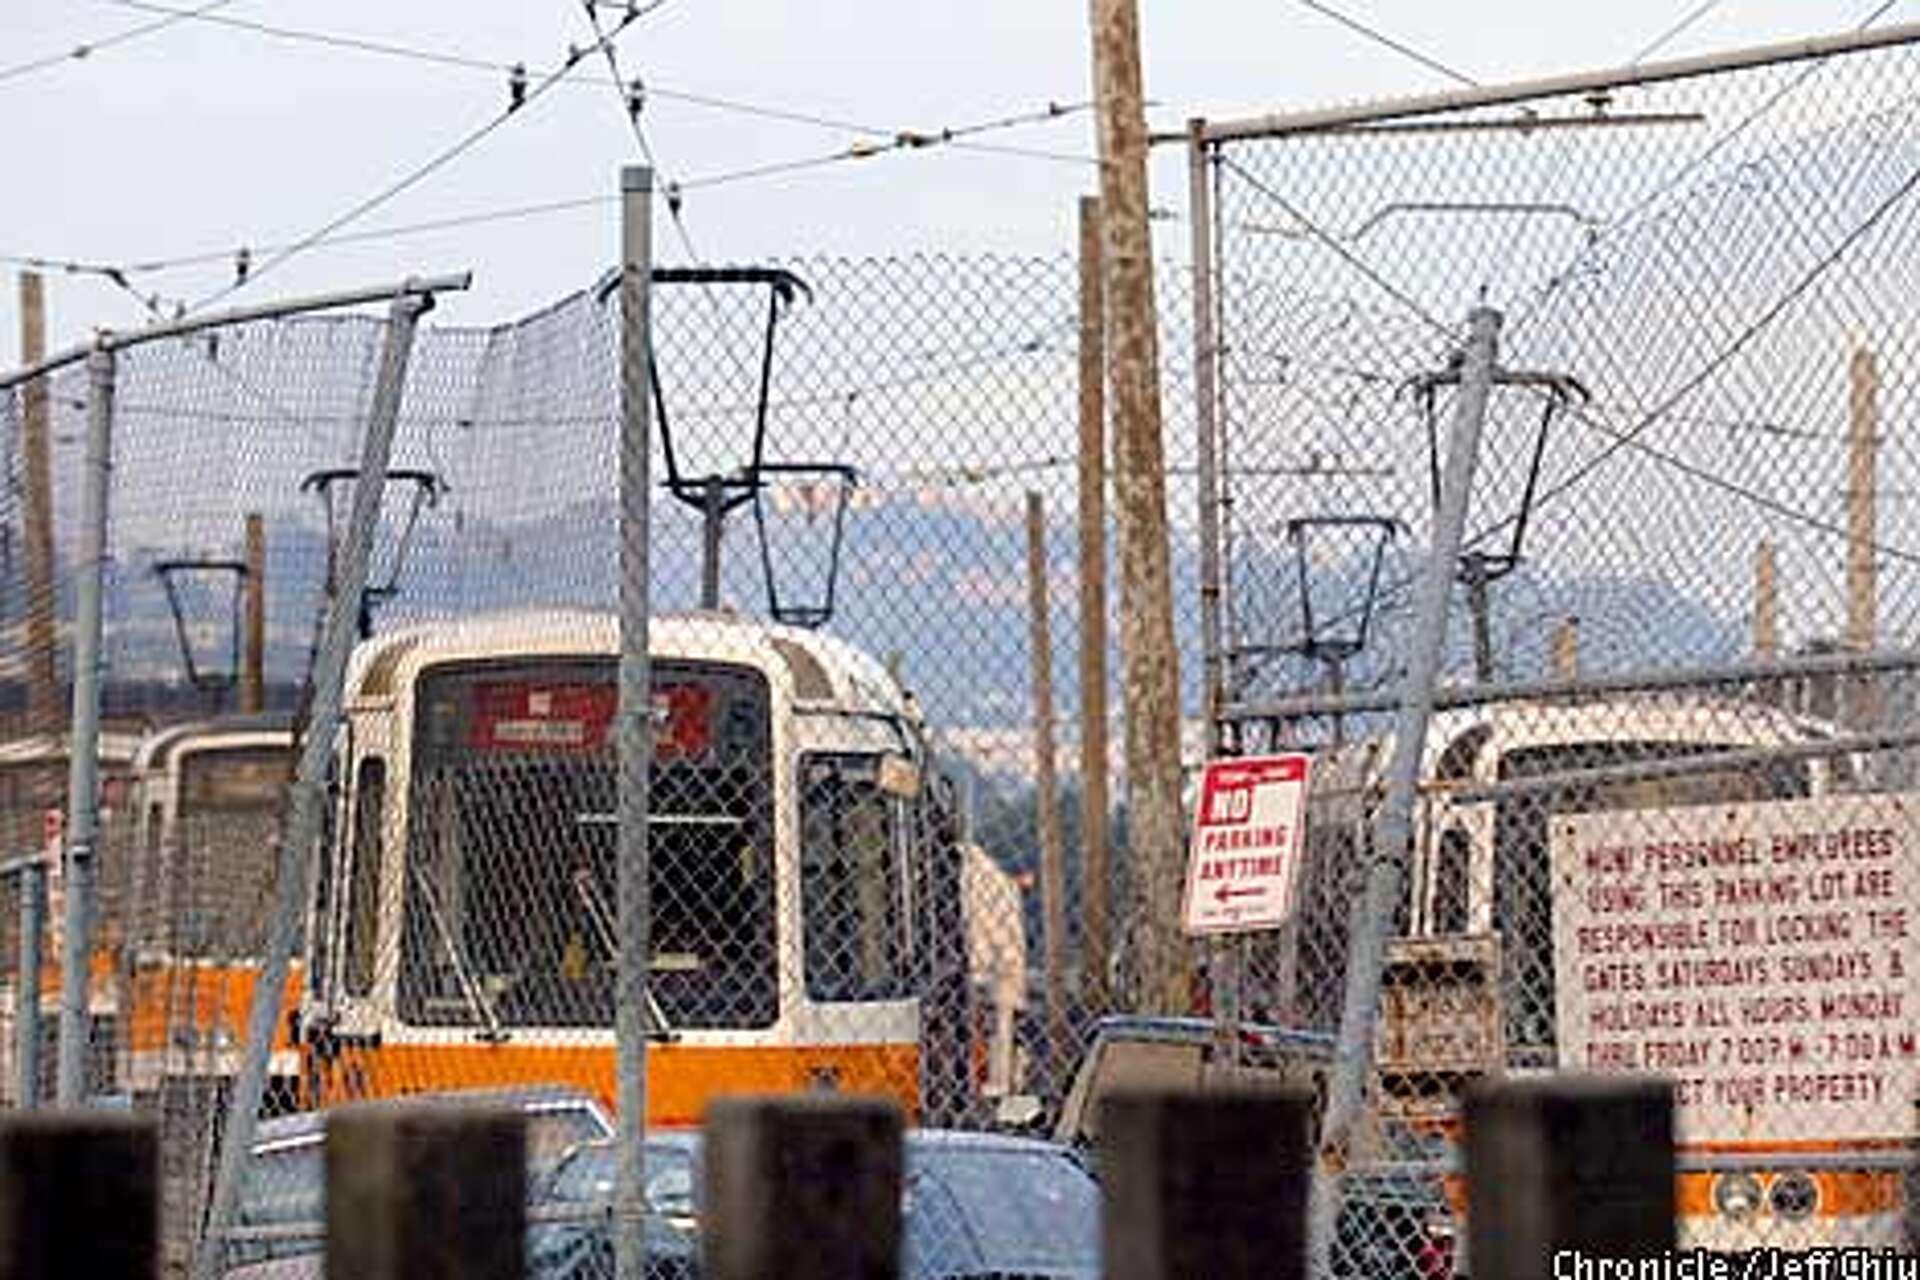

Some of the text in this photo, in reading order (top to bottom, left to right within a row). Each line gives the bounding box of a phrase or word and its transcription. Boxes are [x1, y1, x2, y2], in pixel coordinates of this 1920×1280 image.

[1212, 788, 1249, 820] NO
[1206, 828, 1287, 851] PARKING
[1644, 835, 1760, 872] PERSONNEL
[1770, 827, 1895, 864] EMPLOYEES
[1200, 856, 1281, 879] ANYTIME
[1586, 870, 1893, 913] USING THIS PARKING LOT ARE
[1577, 920, 1708, 953] RESPONSIBLE
[1766, 911, 1850, 945] LOCKING
[1867, 907, 1908, 937] THE
[1583, 963, 1645, 992] GATES
[1658, 957, 1768, 987] SATURDAYS
[1780, 951, 1872, 982] SUNDAYS
[1590, 991, 1903, 1032] HOLIDAYS ALL HOURS MONDAY
[1644, 1039, 1711, 1068] FRIDAY
[1714, 1077, 1765, 1105] YOUR
[1774, 1072, 1885, 1103] PROPERTY
